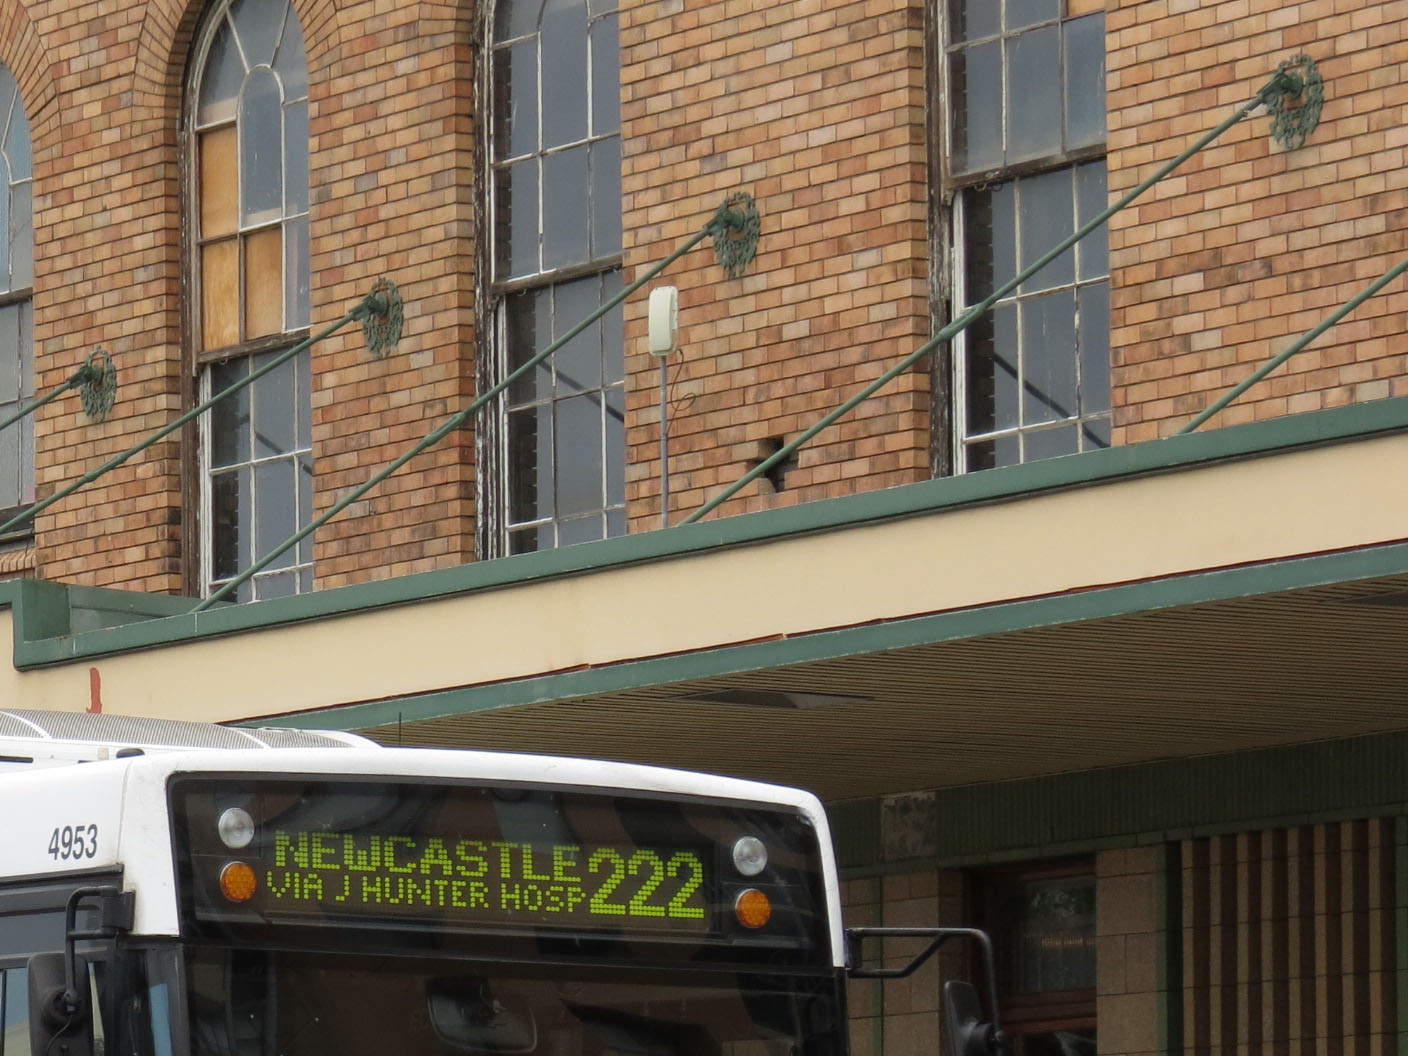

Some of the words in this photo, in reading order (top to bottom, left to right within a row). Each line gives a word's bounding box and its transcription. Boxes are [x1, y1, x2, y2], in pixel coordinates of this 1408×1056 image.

[48, 823, 98, 861] 4953
[274, 829, 582, 883] NEWCASTLE
[266, 870, 323, 901] VIA
[335, 875, 350, 901] J
[361, 874, 490, 909] HUNTER
[500, 882, 587, 913] HOSP
[587, 847, 705, 919] 222
